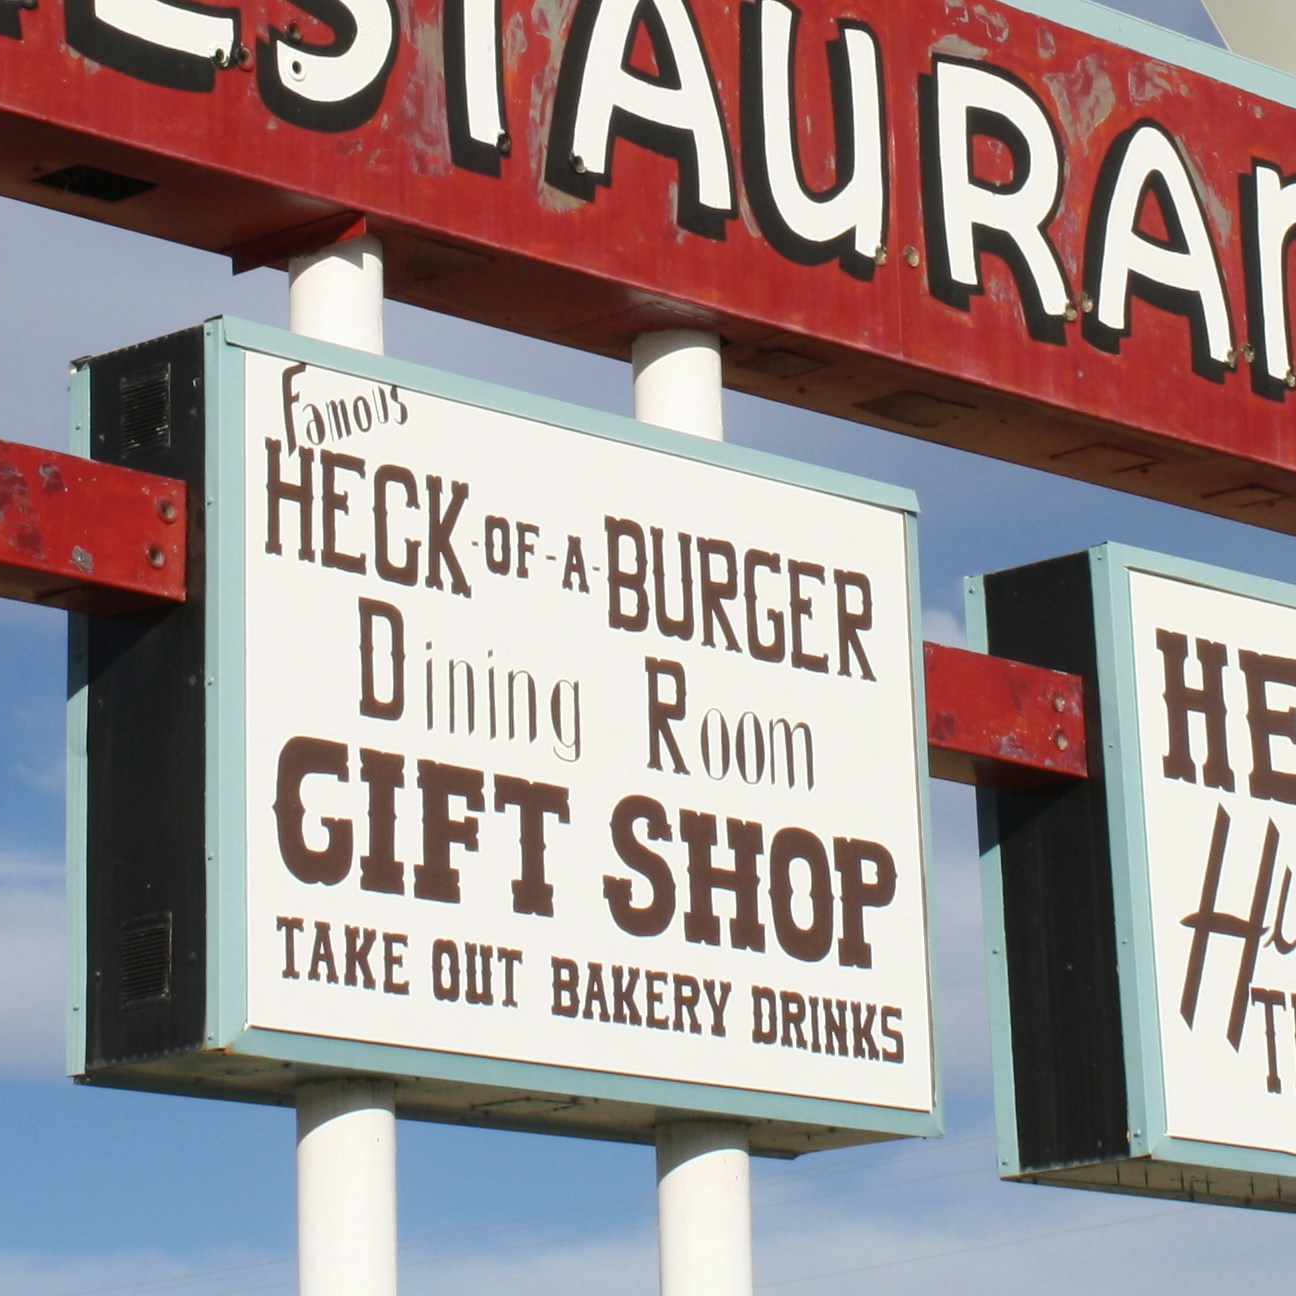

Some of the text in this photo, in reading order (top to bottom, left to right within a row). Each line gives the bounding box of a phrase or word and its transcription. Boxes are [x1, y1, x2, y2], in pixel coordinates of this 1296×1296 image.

[358, 596, 814, 791] Dining Room
[272, 735, 898, 969] GIFT SHOP
[276, 916, 904, 1064] TAKE OUT BAKERY DRINKS
